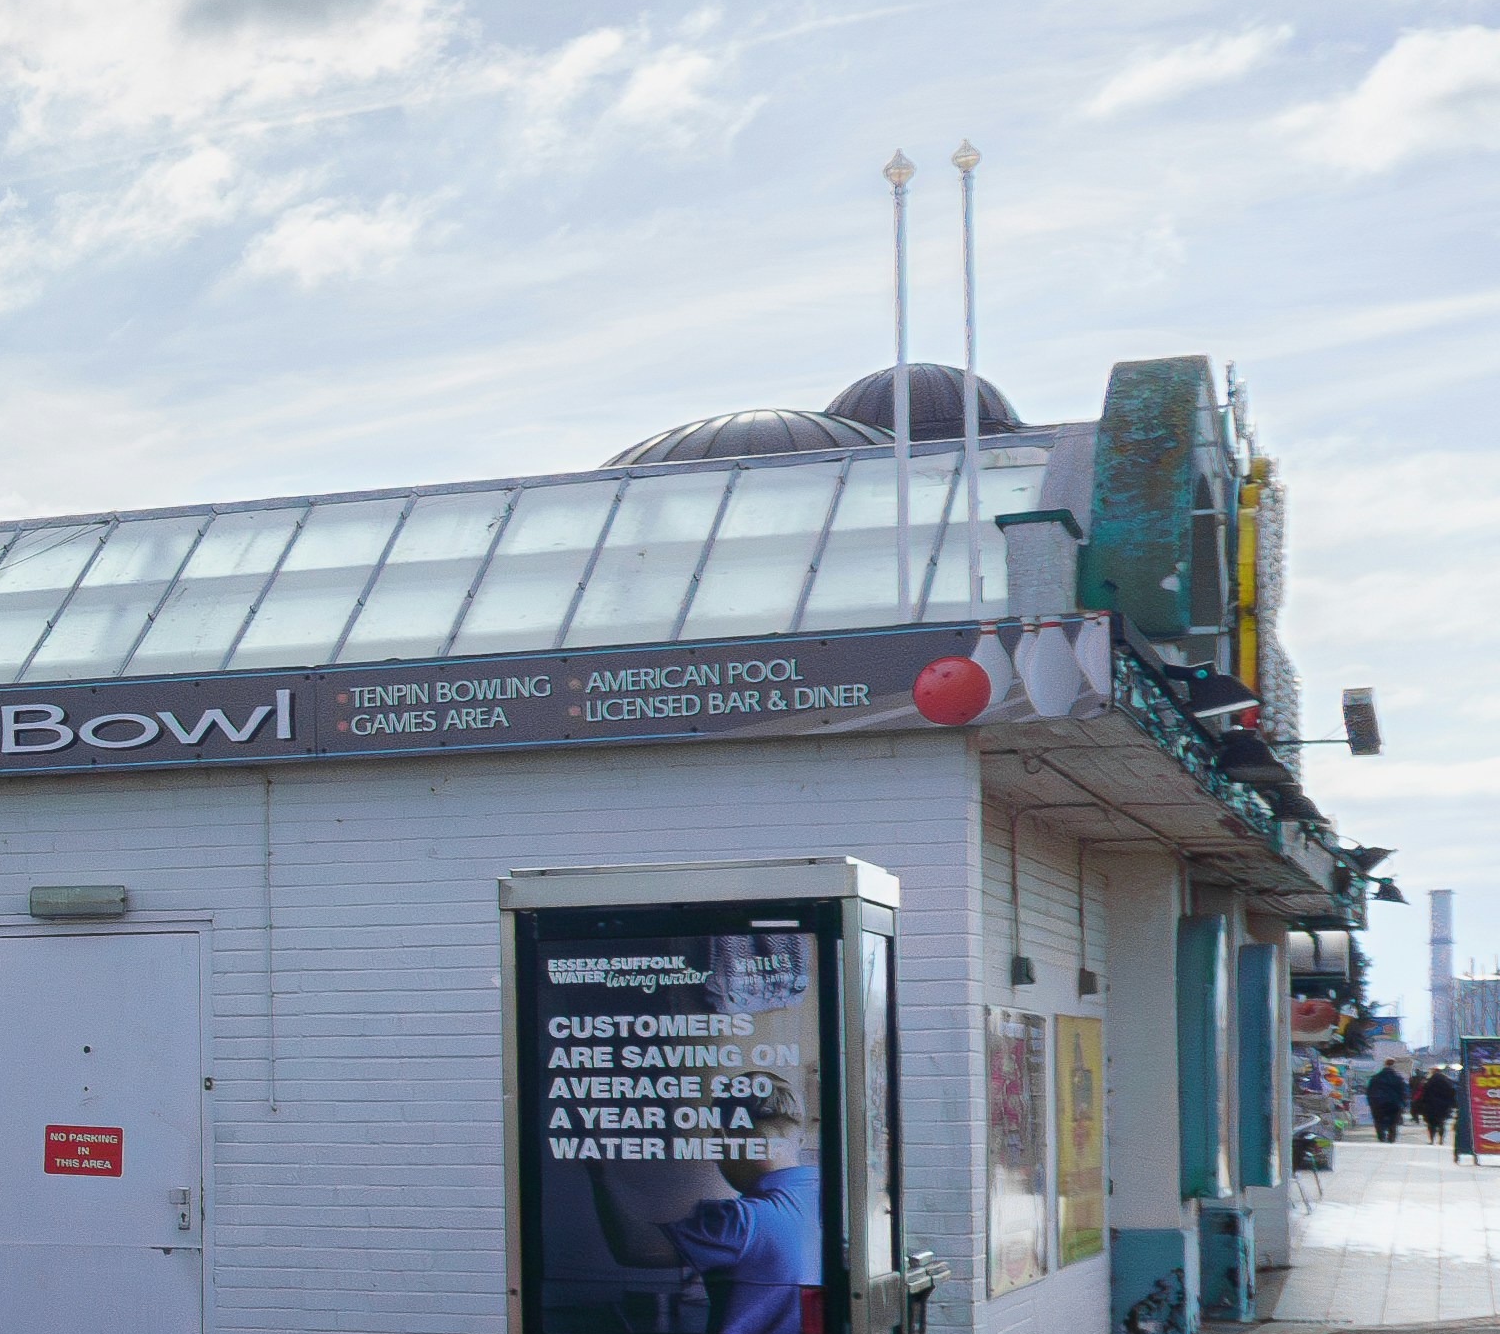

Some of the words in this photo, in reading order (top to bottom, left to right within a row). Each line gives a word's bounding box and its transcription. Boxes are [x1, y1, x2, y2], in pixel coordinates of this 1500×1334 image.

[585, 665, 720, 694] AMERICAN
[728, 658, 803, 685] POOL
[350, 681, 429, 709] TENPIN
[436, 675, 552, 703] BOWLING
[586, 693, 702, 723] LICENSED
[709, 687, 760, 715] BAR
[769, 687, 788, 711] &
[794, 683, 870, 710] DINER
[0, 688, 296, 755] Bowl
[350, 709, 437, 736] GAMES
[443, 704, 509, 731] AREA
[549, 971, 605, 985] WATER
[606, 970, 656, 994] living
[659, 969, 713, 985] water
[548, 1014, 755, 1038] CUSTOMERS
[548, 1045, 614, 1068] ARE
[621, 1044, 743, 1067] SAVING
[751, 1044, 800, 1067] ON
[548, 1076, 701, 1098] AVERAGE
[711, 1075, 772, 1098] £80
[549, 1107, 572, 1129] A
[577, 1107, 666, 1129] YEAR
[673, 1107, 721, 1129] ON
[729, 1107, 754, 1129] A
[50, 1132, 66, 1141] NO
[69, 1133, 118, 1144] PARKING
[549, 1137, 666, 1160] WATER
[78, 1146, 90, 1155] IN
[55, 1158, 80, 1168] THIS
[82, 1159, 112, 1169] AREA
